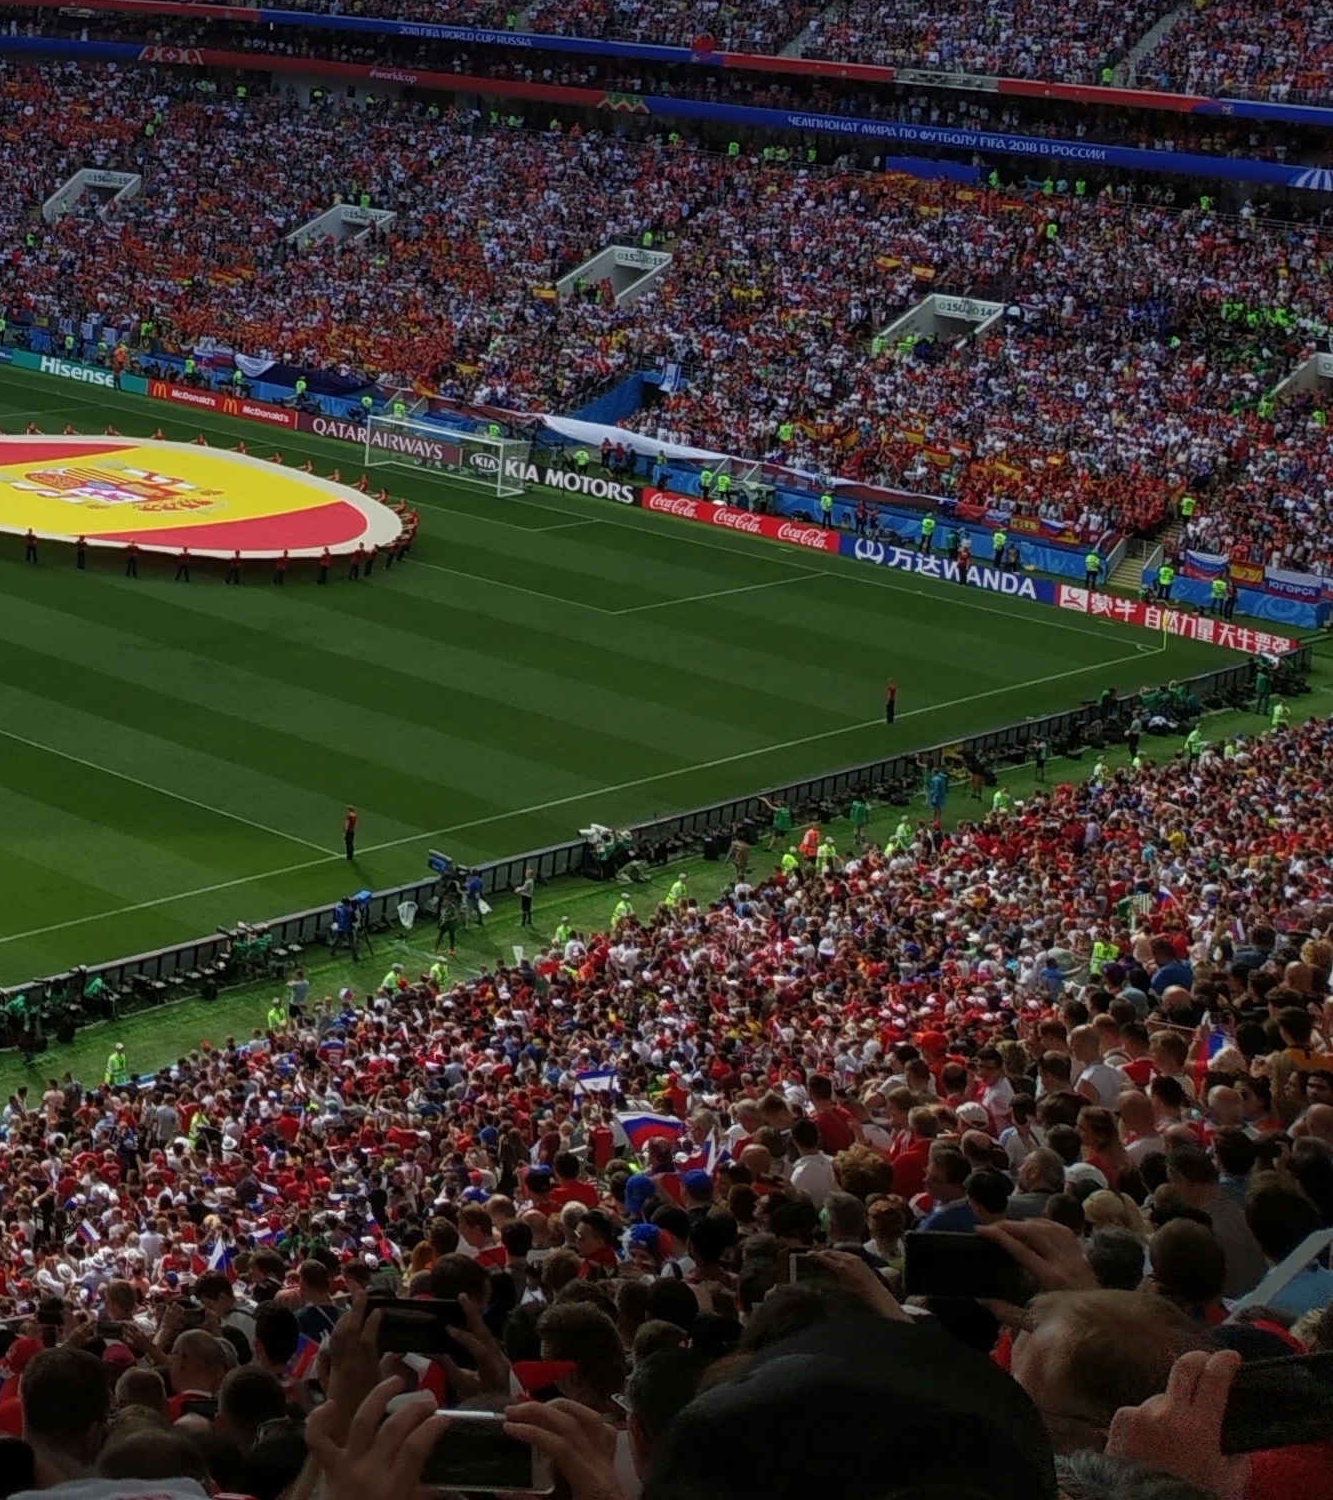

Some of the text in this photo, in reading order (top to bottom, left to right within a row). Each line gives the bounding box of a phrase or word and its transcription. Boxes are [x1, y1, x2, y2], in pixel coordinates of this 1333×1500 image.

[399, 26, 532, 46] 2018 FIFA WORLD CUP RUSSIA
[370, 69, 417, 84] #worldcup
[788, 115, 1105, 160] ЧЕМПИОНАТ МИРА ПО ФУТБОЛУ FIFA 2018 В РОССИИ
[40, 355, 114, 388] Hisense
[171, 389, 216, 406] McDonald's
[242, 405, 289, 423] McDonald's
[312, 417, 443, 460] QATAR AIRWAYS
[505, 459, 539, 483] KIA
[545, 468, 633, 504] MOTORS
[888, 546, 940, 579] 万达
[1091, 591, 1138, 622] 蒙牛
[1144, 605, 1214, 643] 自然力量
